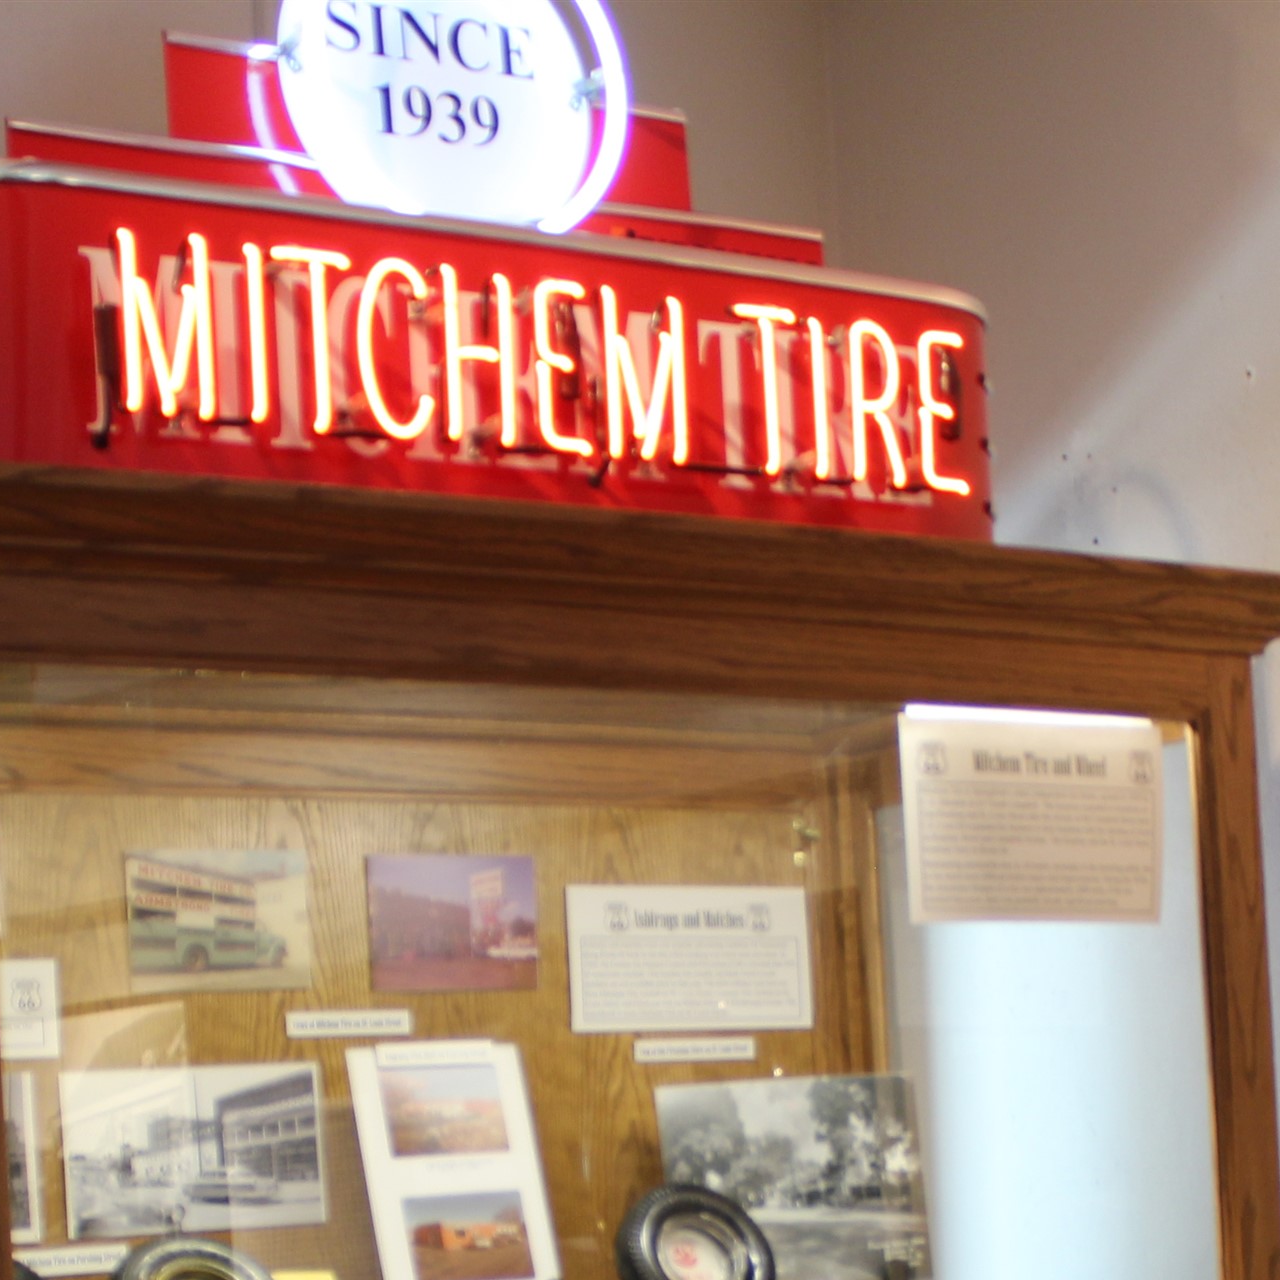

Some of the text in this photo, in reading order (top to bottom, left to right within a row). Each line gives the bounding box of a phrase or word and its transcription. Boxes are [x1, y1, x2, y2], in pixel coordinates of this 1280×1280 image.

[325, 0, 535, 80] SINCE
[375, 82, 500, 146] 1939
[113, 225, 971, 496] MITCHEM TIRE
